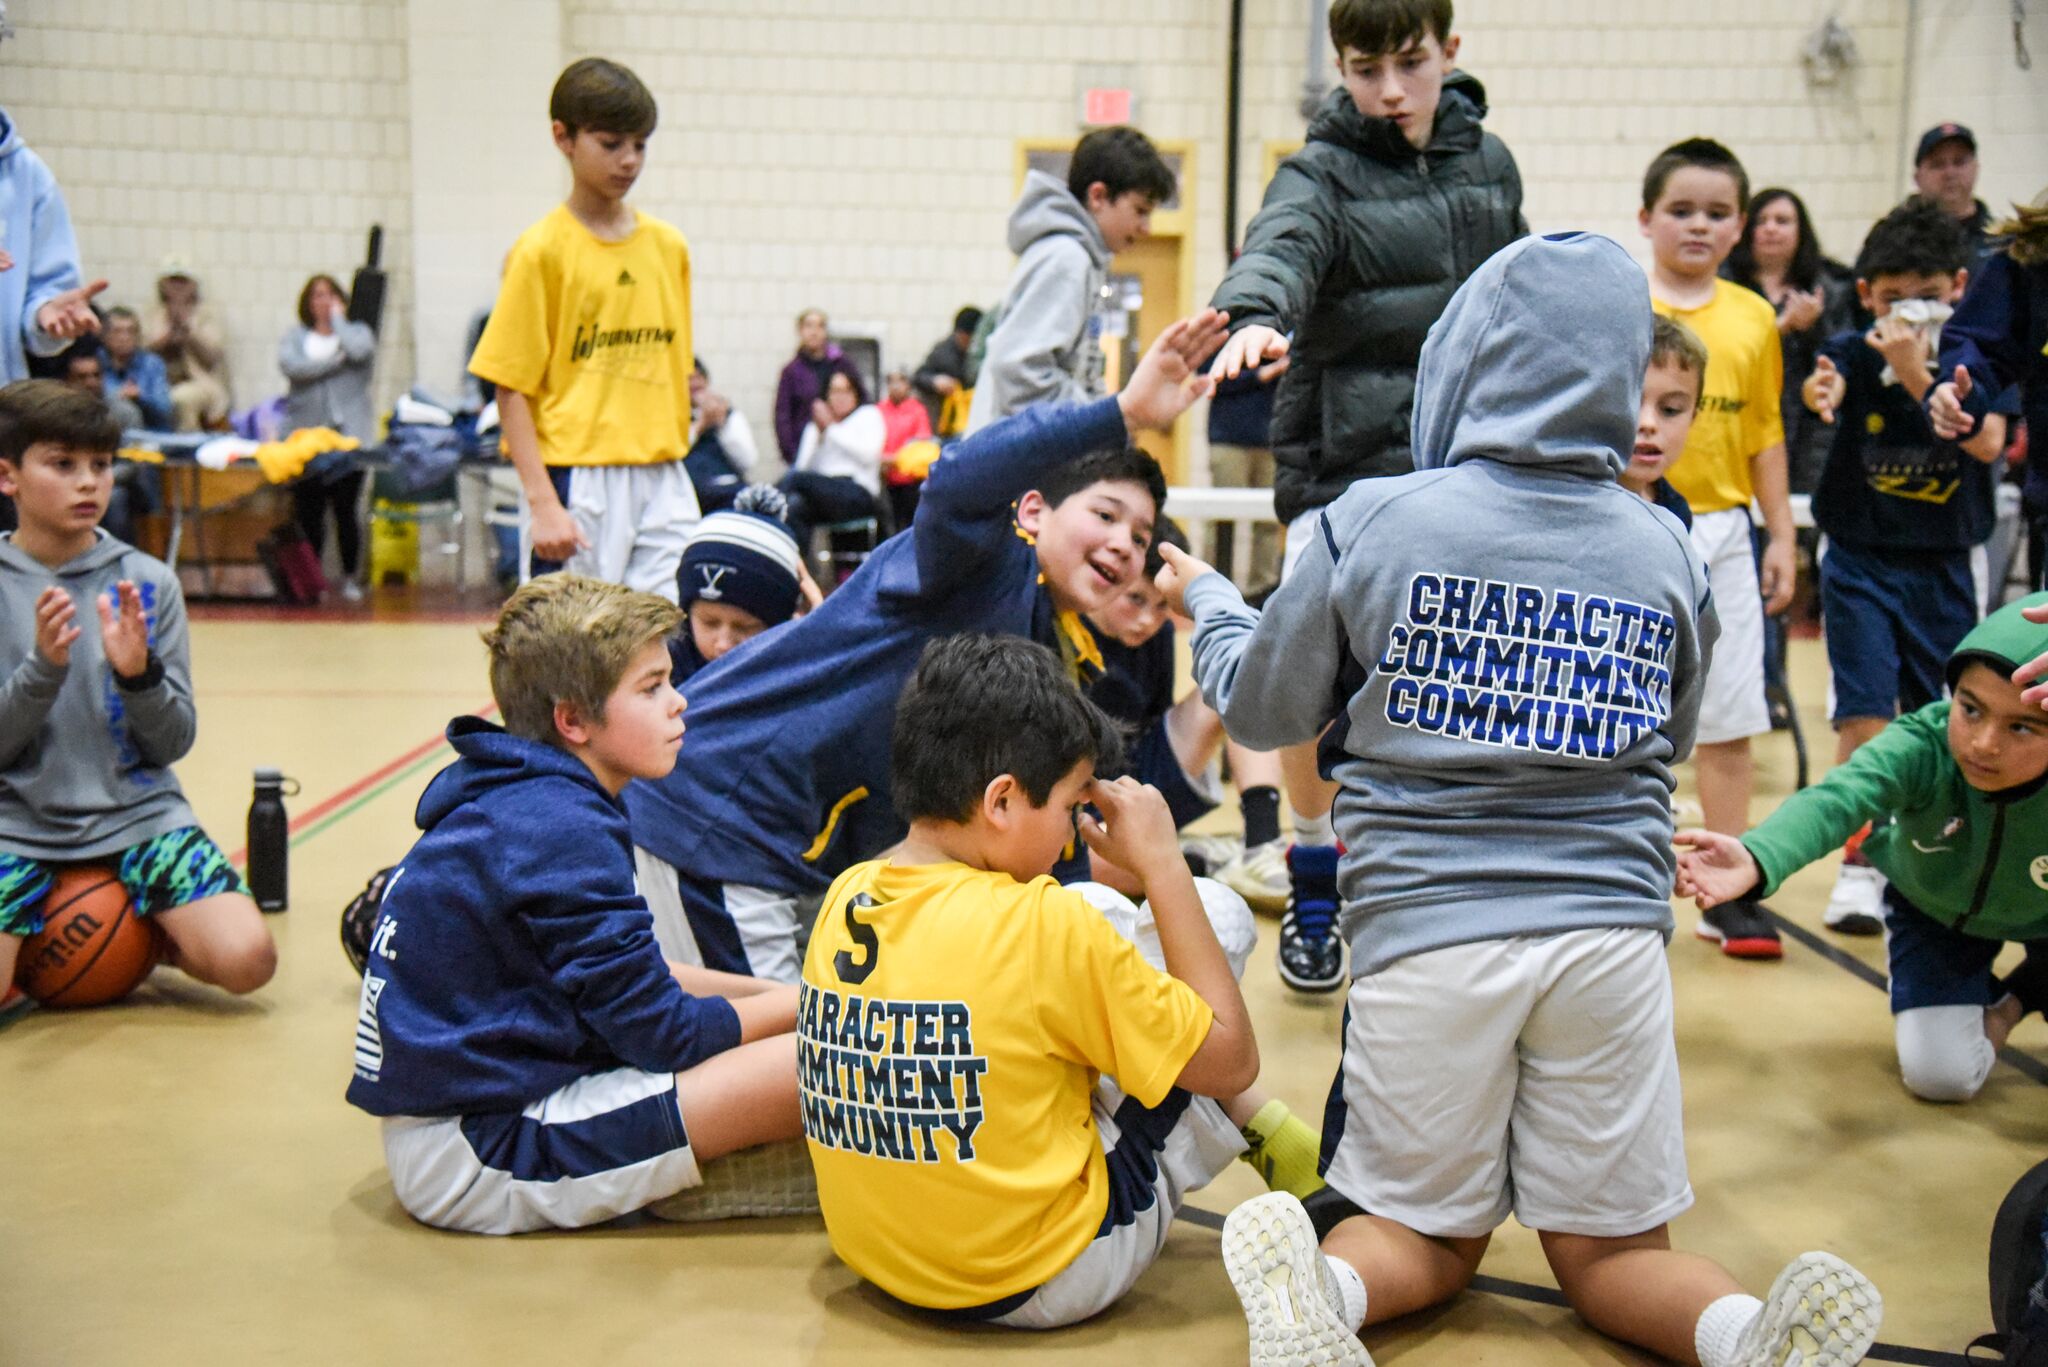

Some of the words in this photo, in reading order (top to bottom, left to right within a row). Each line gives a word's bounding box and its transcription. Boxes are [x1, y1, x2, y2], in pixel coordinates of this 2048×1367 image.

[694, 562, 737, 599] Y
[1406, 572, 1676, 669] CHARACTER
[1377, 624, 1671, 719] COMMITMENT
[1384, 676, 1664, 761] COMMUNIT
[798, 977, 973, 1057] HARACTER
[797, 1037, 988, 1115] MMITMENT
[800, 1088, 985, 1164] MMUNITY
